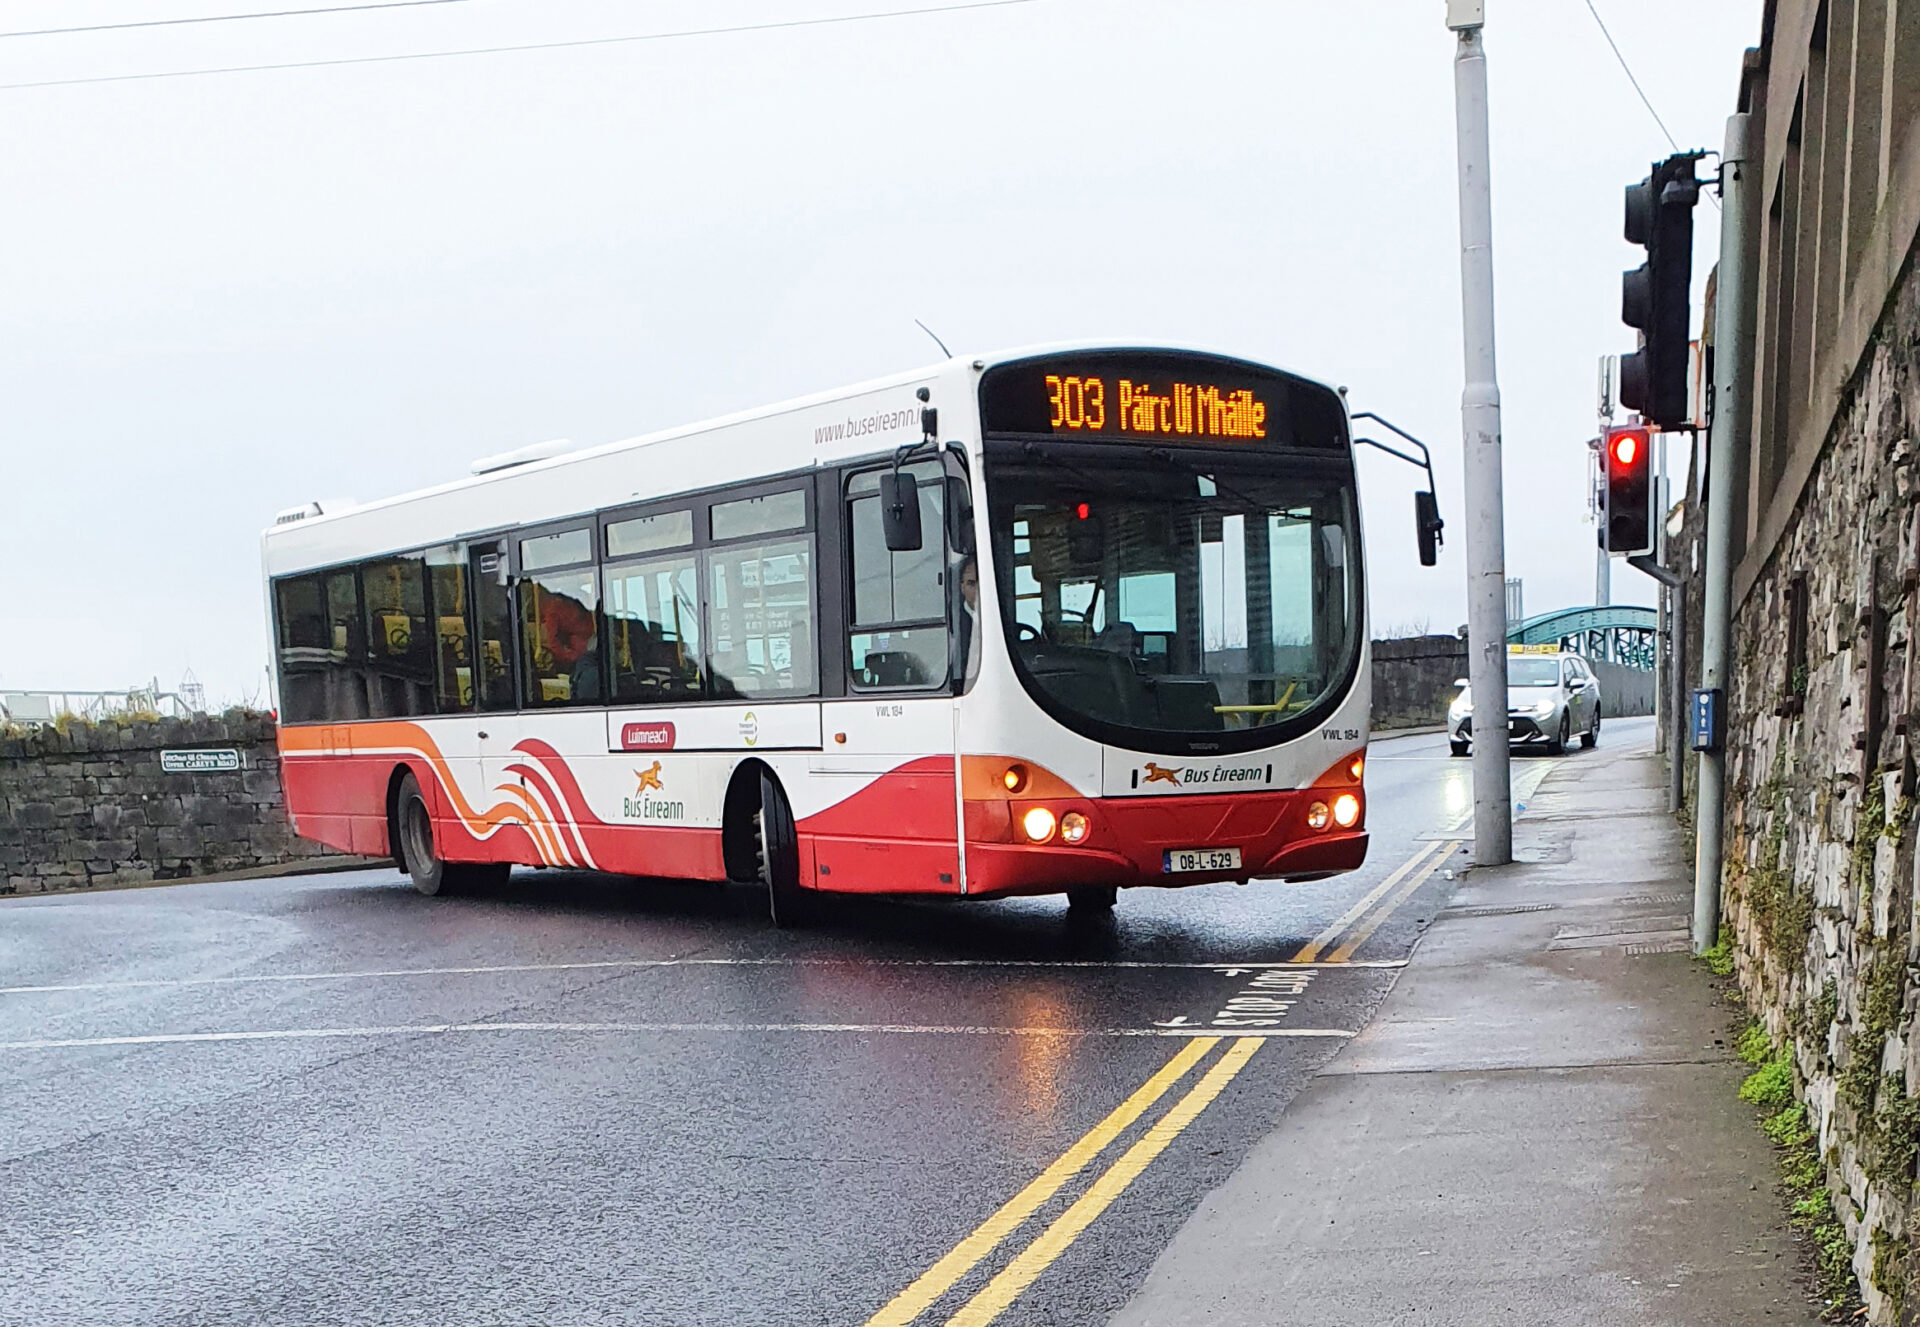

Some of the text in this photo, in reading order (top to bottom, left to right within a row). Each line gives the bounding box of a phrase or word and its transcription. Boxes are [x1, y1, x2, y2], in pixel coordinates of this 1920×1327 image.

[1045, 375, 1266, 438] 303 Páirc Uí Mháille
[814, 402, 925, 445] www.buseireann.i
[1322, 730, 1359, 741] VWL 184
[1183, 764, 1262, 783] Bus Éireann
[623, 793, 684, 820] Bus Éireann
[1180, 853, 1232, 870] 08-L-629
